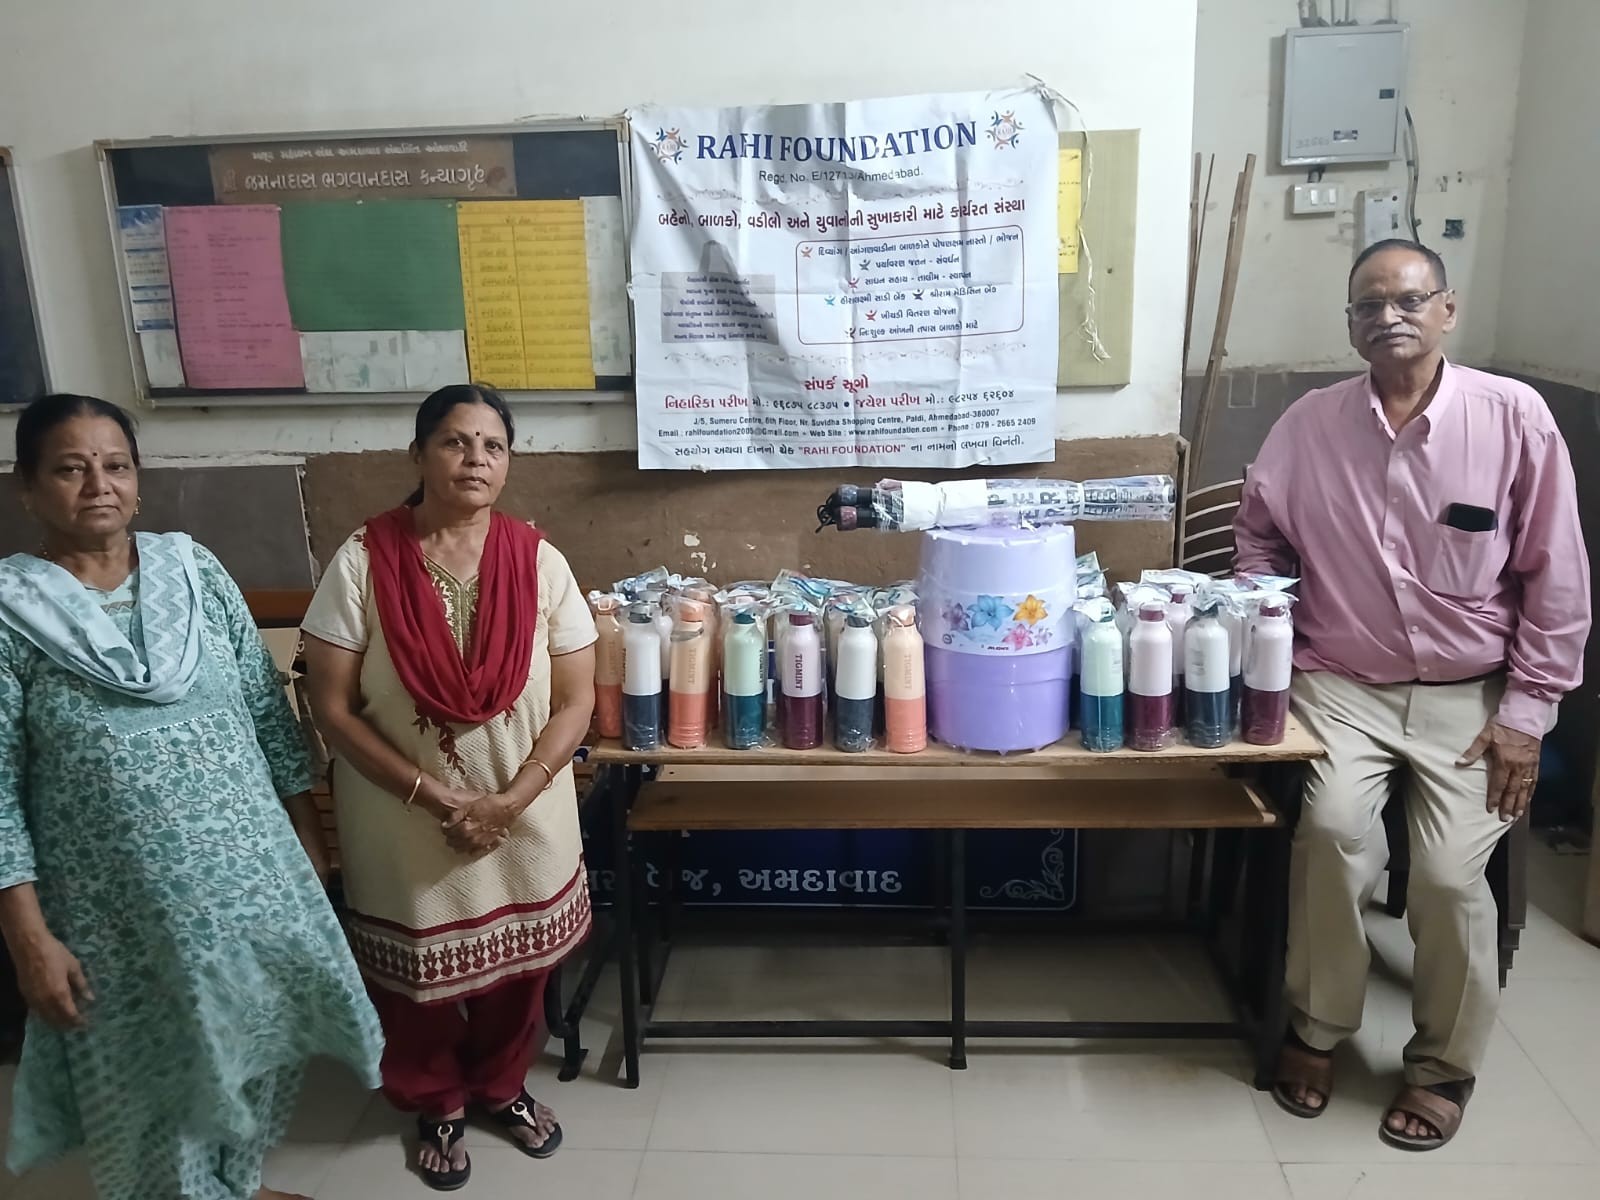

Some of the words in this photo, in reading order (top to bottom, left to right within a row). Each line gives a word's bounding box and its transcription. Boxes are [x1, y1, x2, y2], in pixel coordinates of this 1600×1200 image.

[697, 133, 774, 160] RAHI
[779, 121, 977, 162] FOUNDATION
[244, 170, 316, 192] જમનાદાસ
[321, 168, 410, 190] ભગવાનદાસ
[419, 164, 486, 192] કન્યાગૃહ
[790, 172, 808, 183] No.
[658, 208, 693, 227] બહેનો,
[698, 210, 741, 229] બાળકો,
[747, 211, 781, 229] વડીલો
[787, 212, 810, 229] અને
[816, 209, 864, 233] યુવાનોની
[867, 205, 918, 230] સુખાકારી
[923, 203, 944, 220] માટે
[950, 199, 988, 218] કાર્યરત
[994, 197, 1025, 213] સંસ્થા
[804, 375, 838, 391] સંપર્ક
[664, 394, 715, 409] નિહારિકા
[719, 393, 749, 408] પરીખ
[855, 395, 886, 408] જયેશ
[890, 392, 920, 406] પરીખ
[710, 417, 737, 425] Sumeru
[811, 418, 840, 427] Suvidha
[842, 417, 876, 427] Shopping
[877, 415, 904, 425] Centre,
[658, 429, 679, 438] Email
[809, 429, 825, 438] Web
[827, 429, 842, 437] Site
[675, 446, 710, 456] સહયોગ
[714, 446, 742, 455] અથવા
[746, 444, 775, 455] દાનનો
[779, 443, 794, 455] ચેક
[910, 442, 922, 452] ના
[927, 439, 957, 452] નામનો
[961, 438, 987, 449] લખવા
[795, 654, 804, 690] TIGMINT
[739, 868, 903, 893] અમદાવાદ
